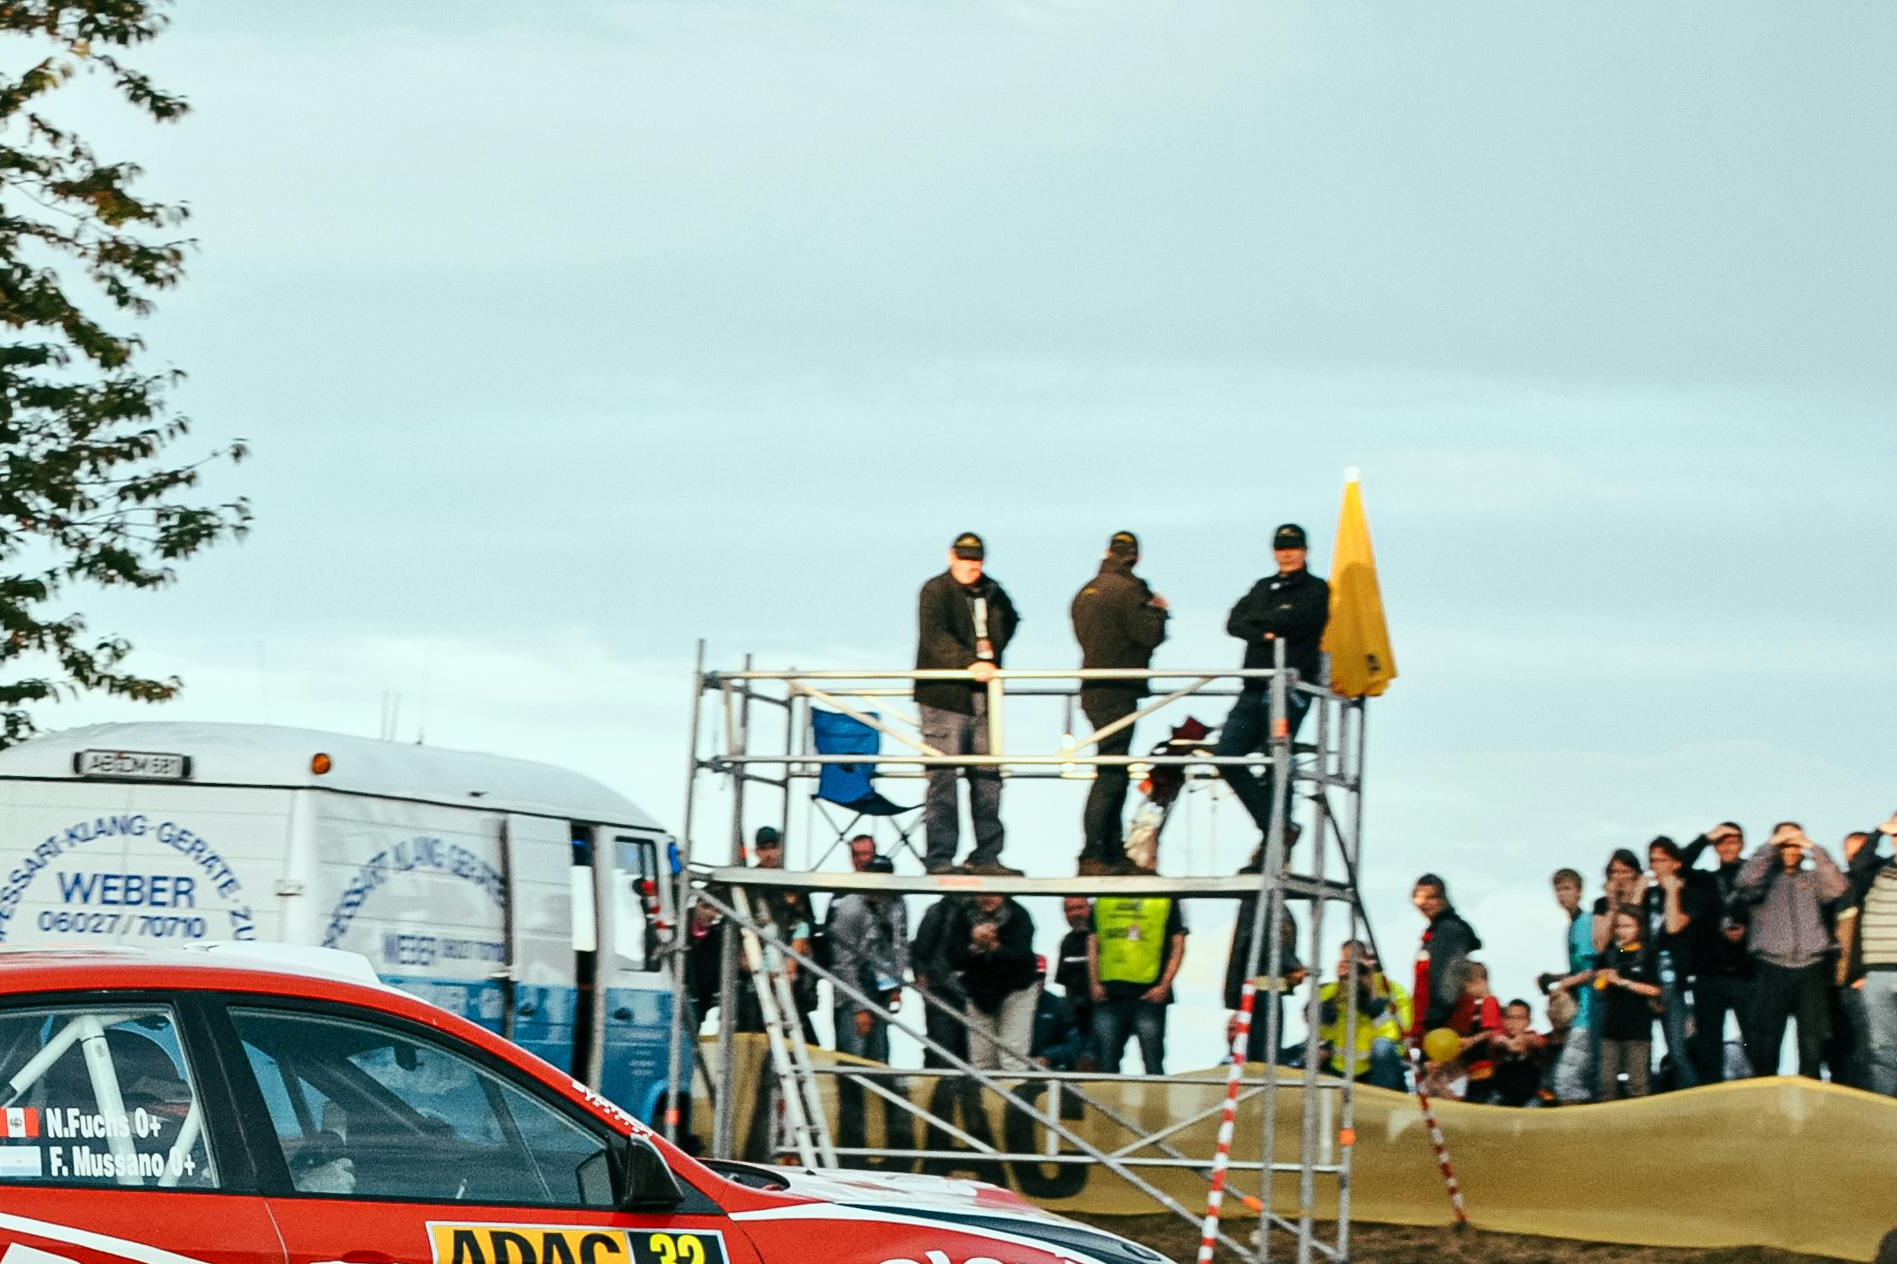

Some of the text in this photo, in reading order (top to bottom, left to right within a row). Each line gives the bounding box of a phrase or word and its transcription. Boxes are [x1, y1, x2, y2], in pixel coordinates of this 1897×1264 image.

[57, 871, 196, 908] WEBER
[49, 1146, 69, 1177] F.
[71, 1145, 165, 1178] Mussano
